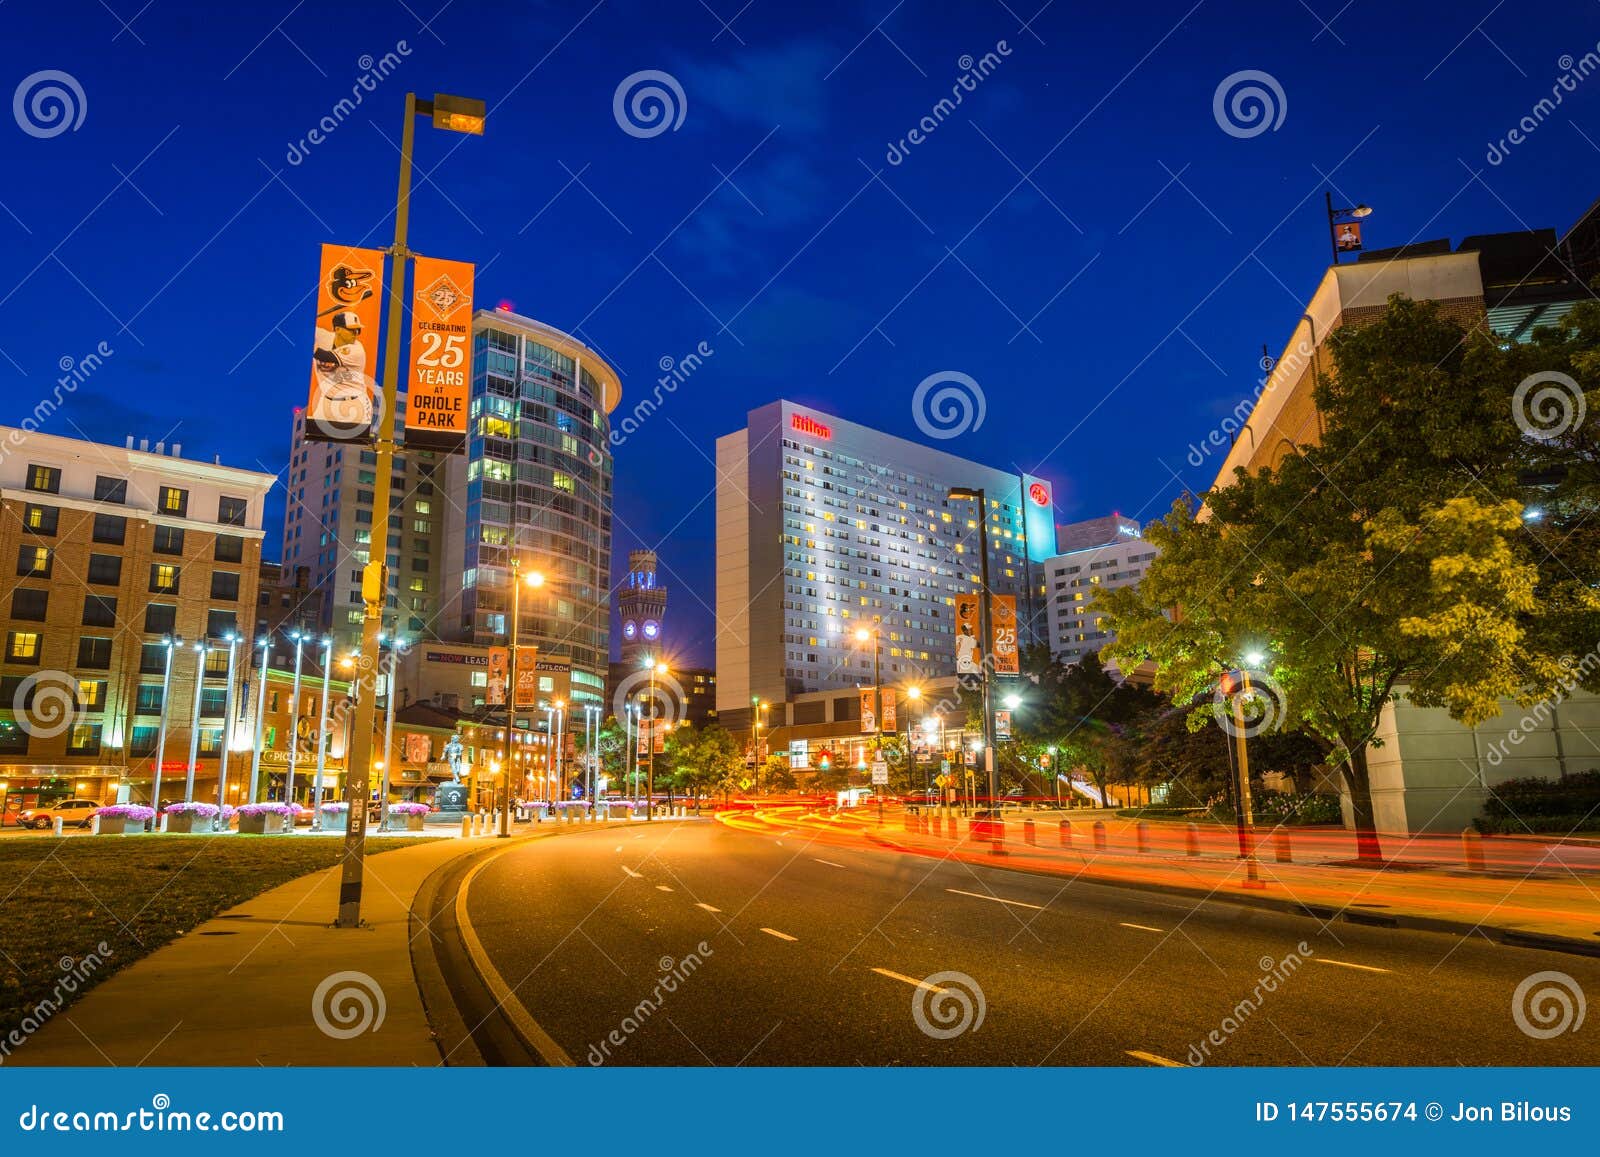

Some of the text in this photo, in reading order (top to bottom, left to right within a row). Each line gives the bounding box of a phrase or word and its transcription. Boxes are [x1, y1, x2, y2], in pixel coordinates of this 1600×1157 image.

[419, 321, 466, 333] CELEBRATING
[417, 333, 466, 368] 25
[417, 369, 464, 386] YEARS
[434, 386, 444, 394] AT
[414, 395, 462, 411] ORIOLE
[418, 411, 456, 427] PARK
[792, 413, 832, 440] Hilton
[996, 628, 1015, 644] 25
[440, 654, 463, 664] NOW
[465, 655, 489, 666] LEASI
[519, 671, 534, 683] 25
